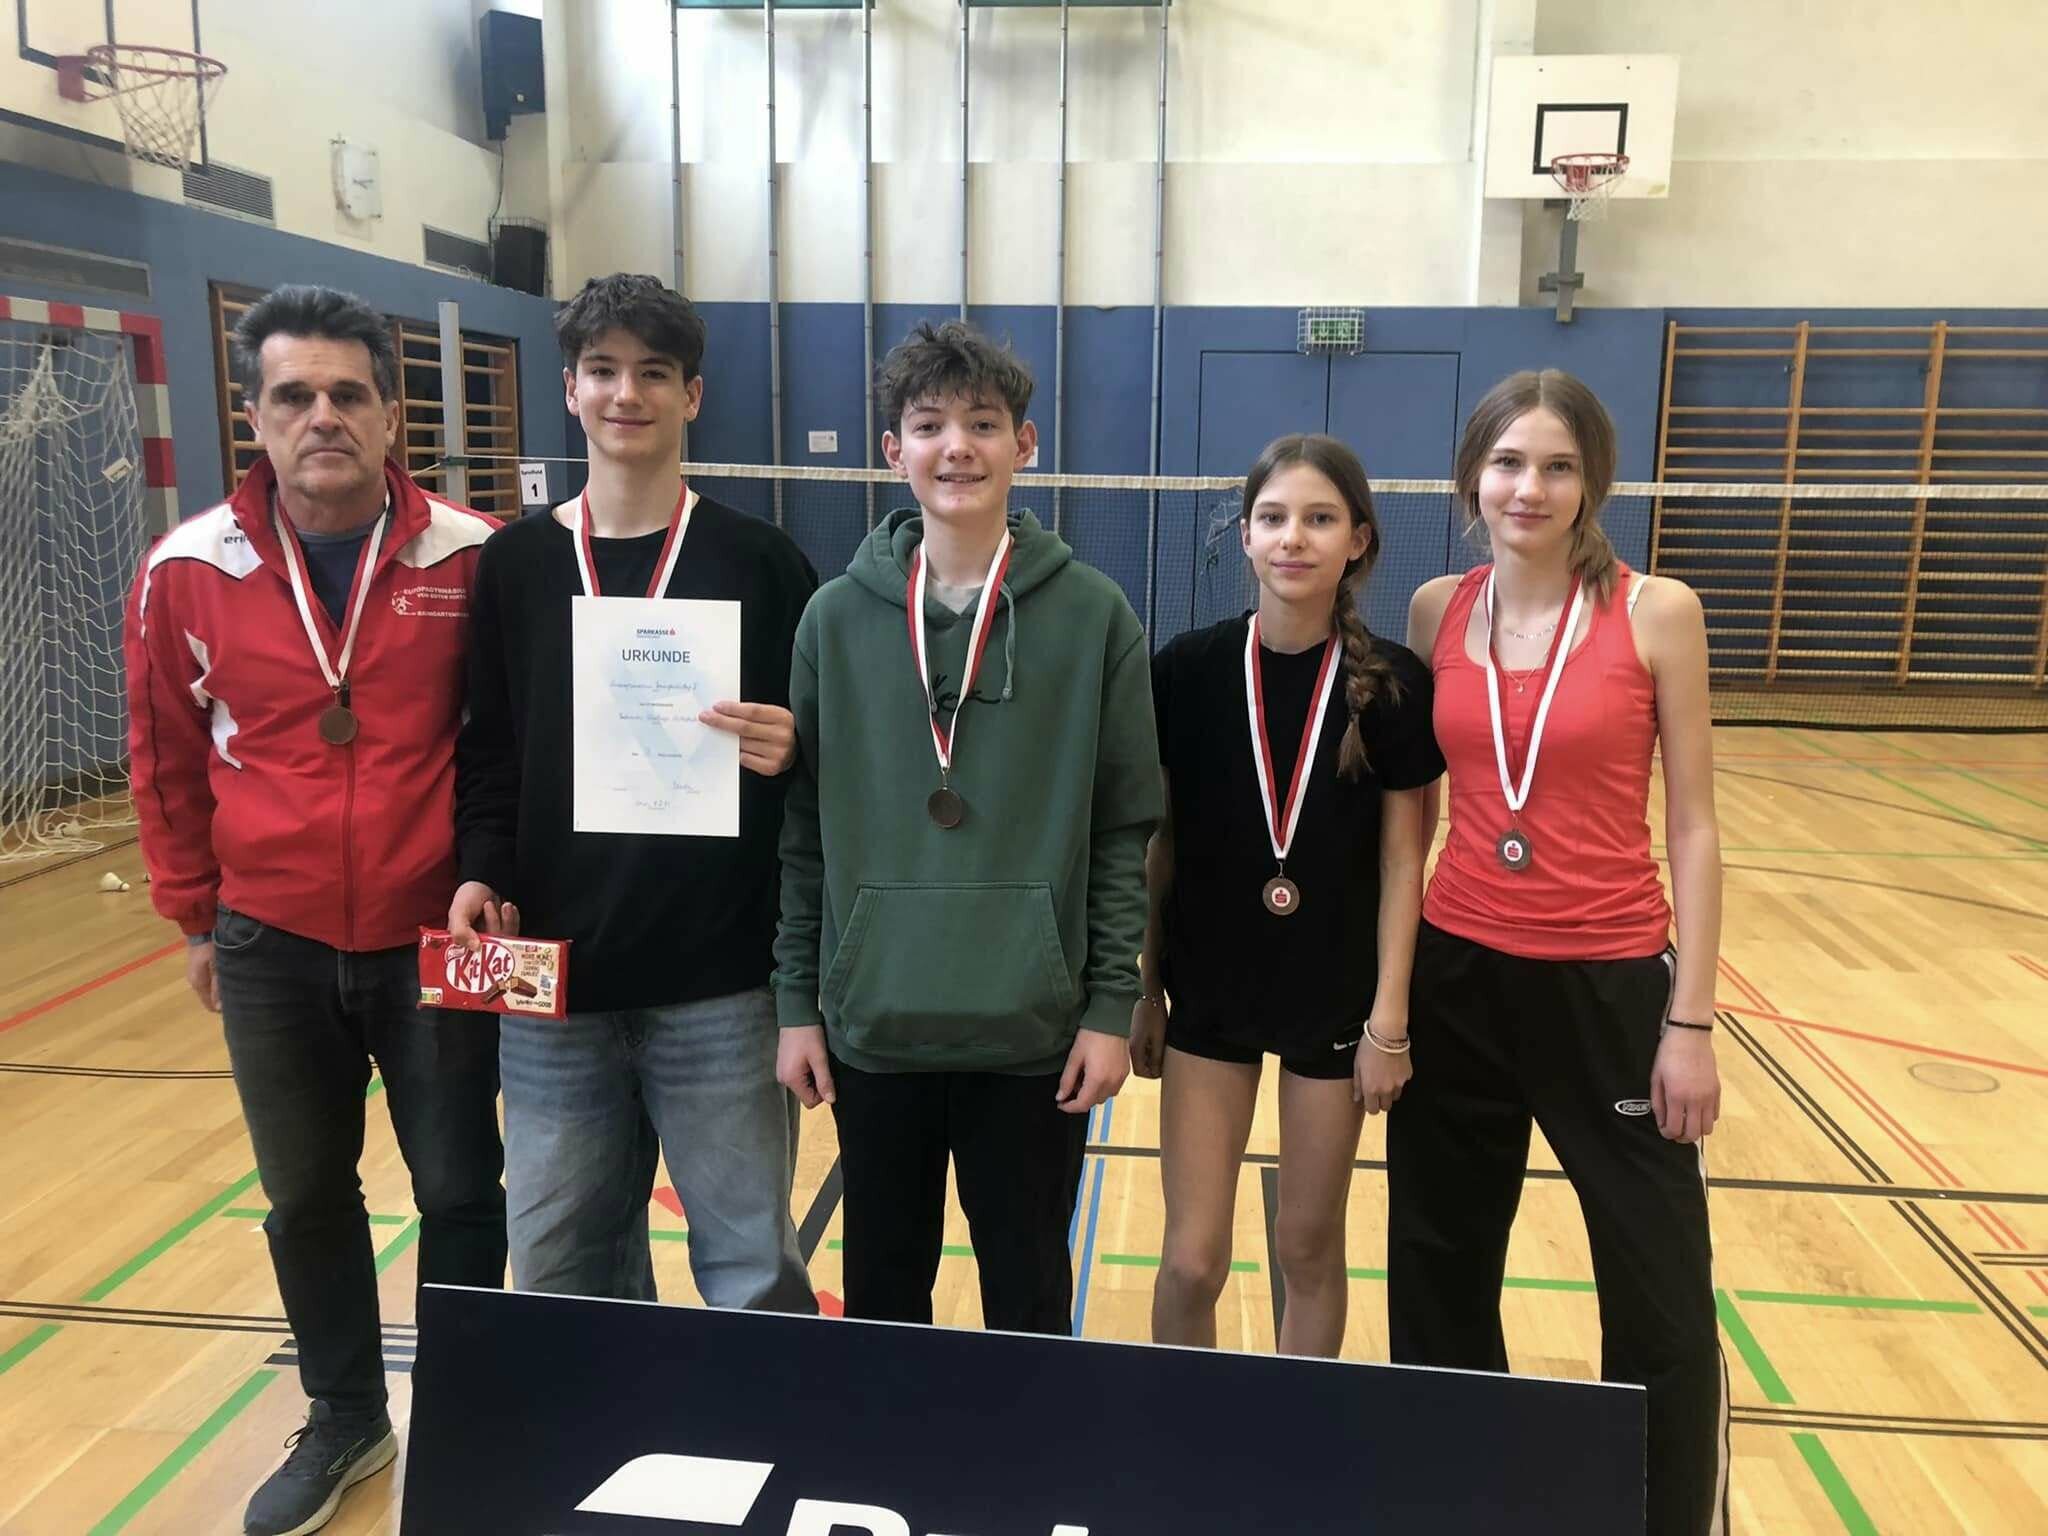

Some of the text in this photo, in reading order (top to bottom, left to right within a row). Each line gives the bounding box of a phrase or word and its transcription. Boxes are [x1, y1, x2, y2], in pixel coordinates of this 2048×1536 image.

[531, 483, 538, 497] 1
[224, 533, 246, 544] eri
[622, 648, 691, 664] URKUNDE
[453, 943, 512, 992] KitKat
